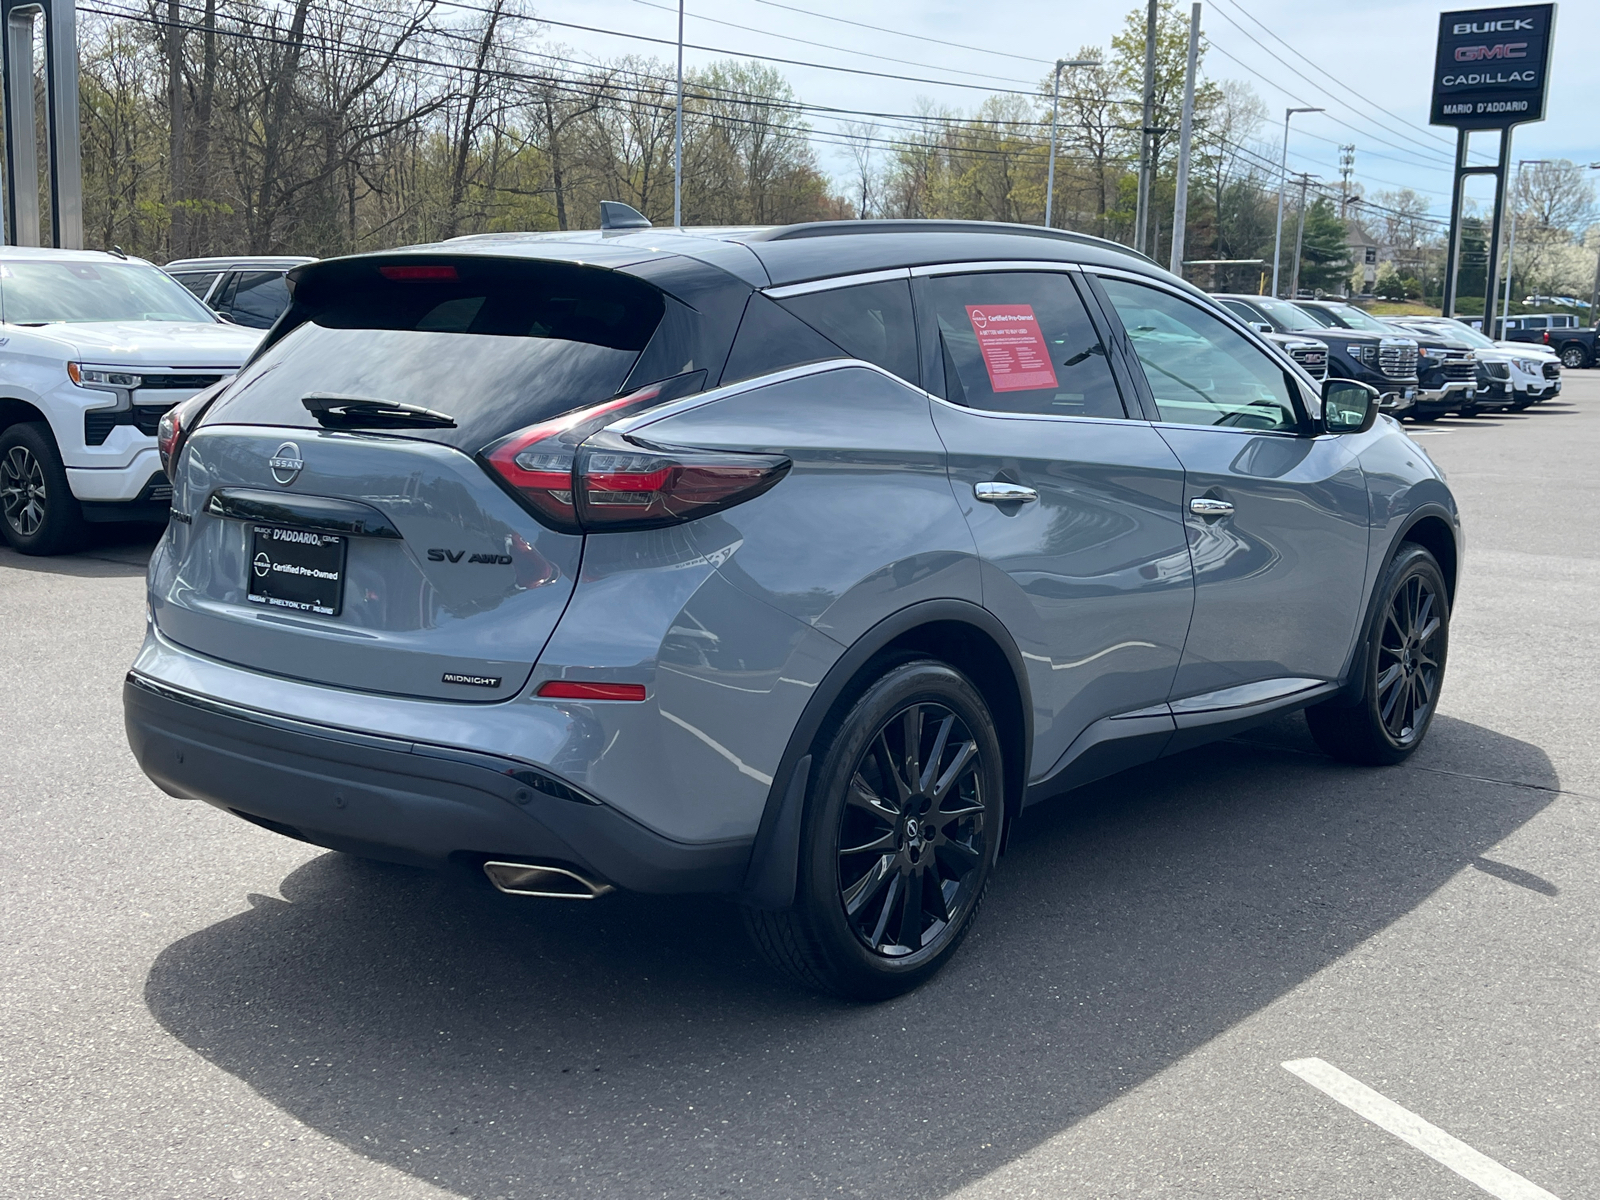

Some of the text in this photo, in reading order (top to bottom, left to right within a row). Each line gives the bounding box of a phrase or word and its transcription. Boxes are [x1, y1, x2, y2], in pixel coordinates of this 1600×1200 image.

[1453, 19, 1534, 35] BUICK
[1455, 42, 1528, 62] GMC
[1442, 71, 1535, 86] CADILLAC
[1443, 100, 1528, 115] MARIO D'ADDARIO
[254, 526, 272, 534] BUICK
[273, 529, 318, 545] D'ADDARIO
[322, 535, 340, 543] GMC
[427, 548, 513, 565] SV AWD
[272, 563, 338, 580] Certified Pre-Owned
[269, 598, 300, 610] SHELTON,
[444, 674, 497, 686] MIDNIGHT
